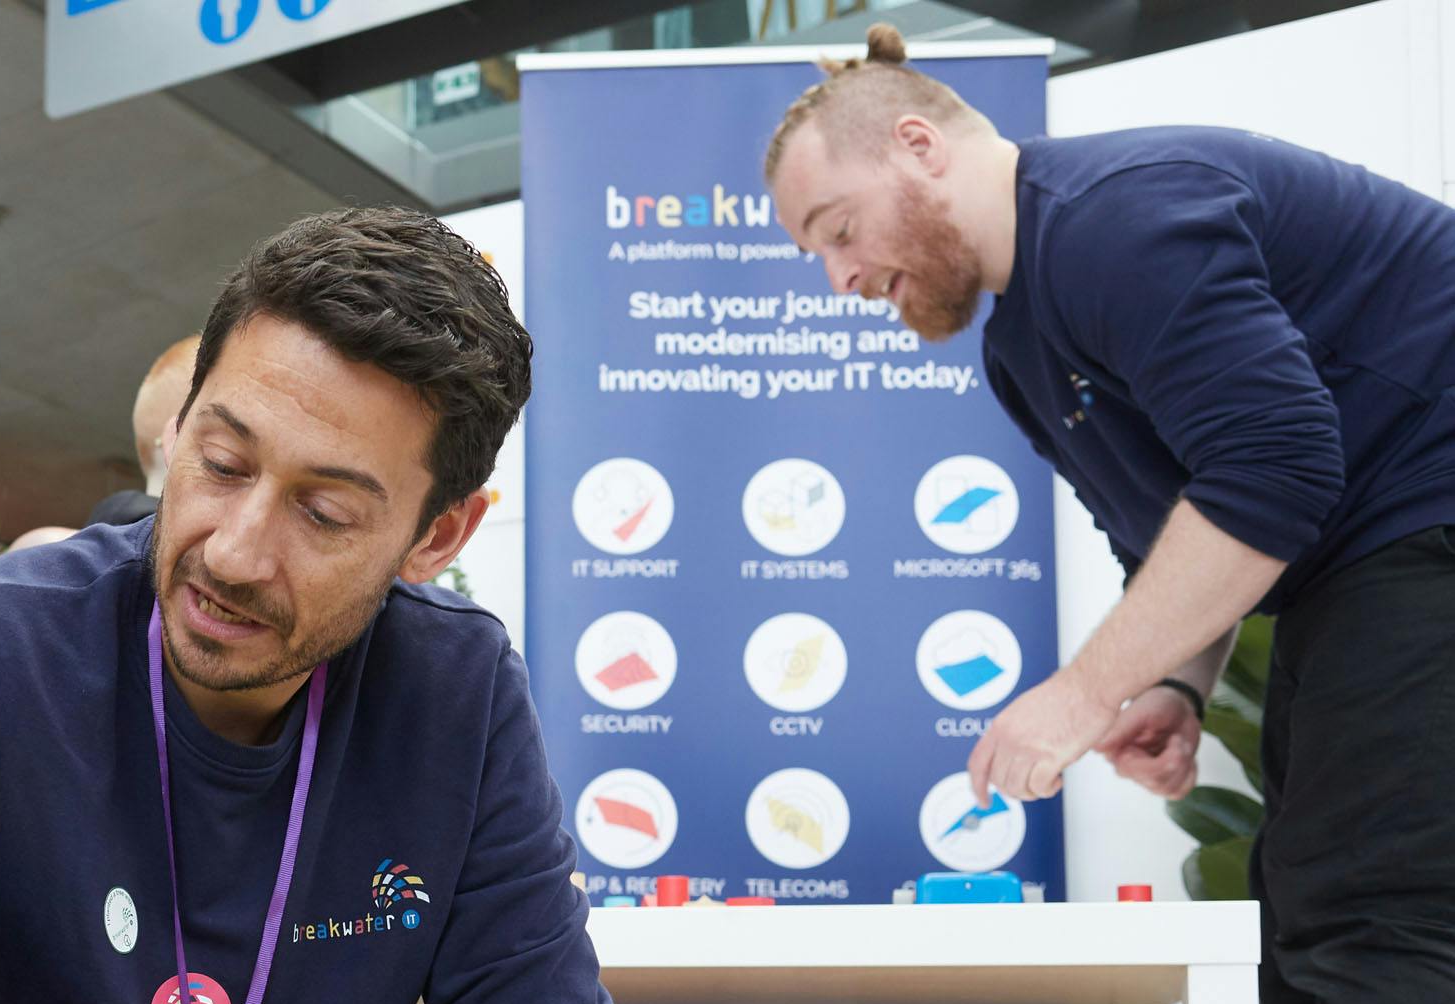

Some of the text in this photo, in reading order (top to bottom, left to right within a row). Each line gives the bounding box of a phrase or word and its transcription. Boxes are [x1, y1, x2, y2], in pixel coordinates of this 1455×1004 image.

[605, 184, 772, 229] breakw
[608, 241, 626, 261] A
[627, 239, 714, 264] platform
[715, 241, 738, 260] to
[629, 289, 900, 325] Start your journey
[655, 326, 851, 360] modernising
[599, 360, 980, 399] innovating your IT today.
[572, 559, 680, 578] IT SUPPORT
[741, 559, 849, 579] IT SYSTEMS
[894, 558, 1042, 581] MICROSOFT 365
[580, 714, 673, 734] SECURITY
[769, 716, 823, 736] CCTV
[935, 717, 992, 737] CLOU
[745, 878, 849, 899] TELECOMS
[293, 912, 416, 943] breakwater IT
